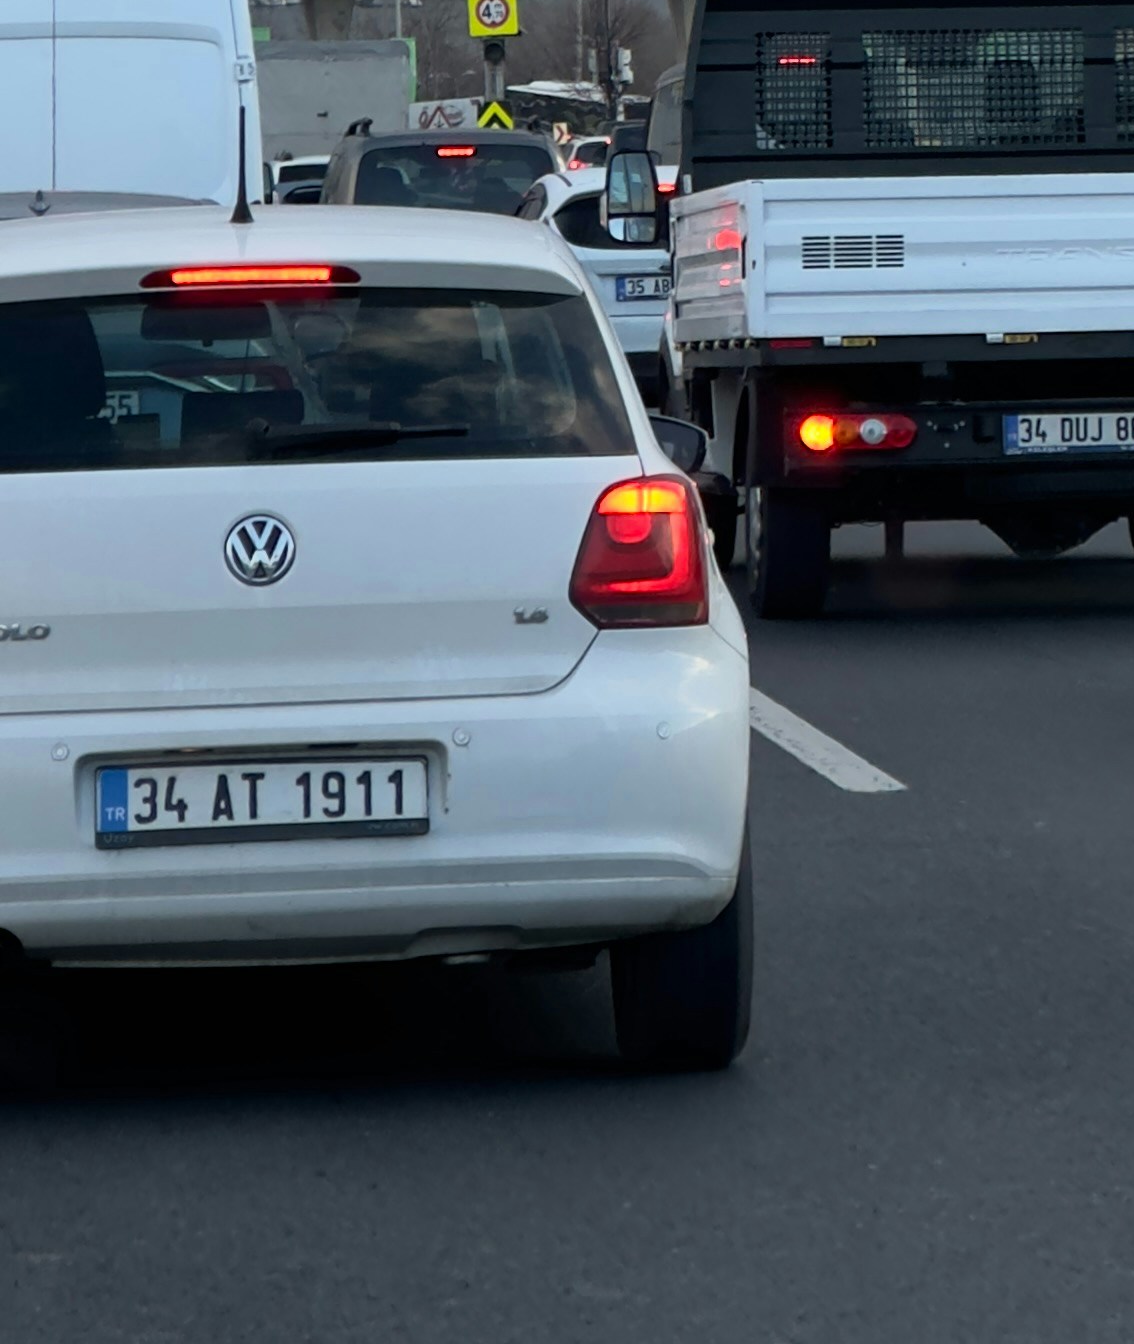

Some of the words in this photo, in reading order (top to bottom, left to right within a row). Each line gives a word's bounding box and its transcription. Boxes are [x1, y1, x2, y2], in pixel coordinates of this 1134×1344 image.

[627, 279, 645, 295] 35
[1020, 417, 1047, 443] 34
[1060, 417, 1103, 443] DUJ
[0, 623, 51, 642] LO
[105, 807, 126, 822] TR
[133, 776, 188, 824] 34
[212, 772, 265, 821] AT
[296, 769, 404, 818] 1911
